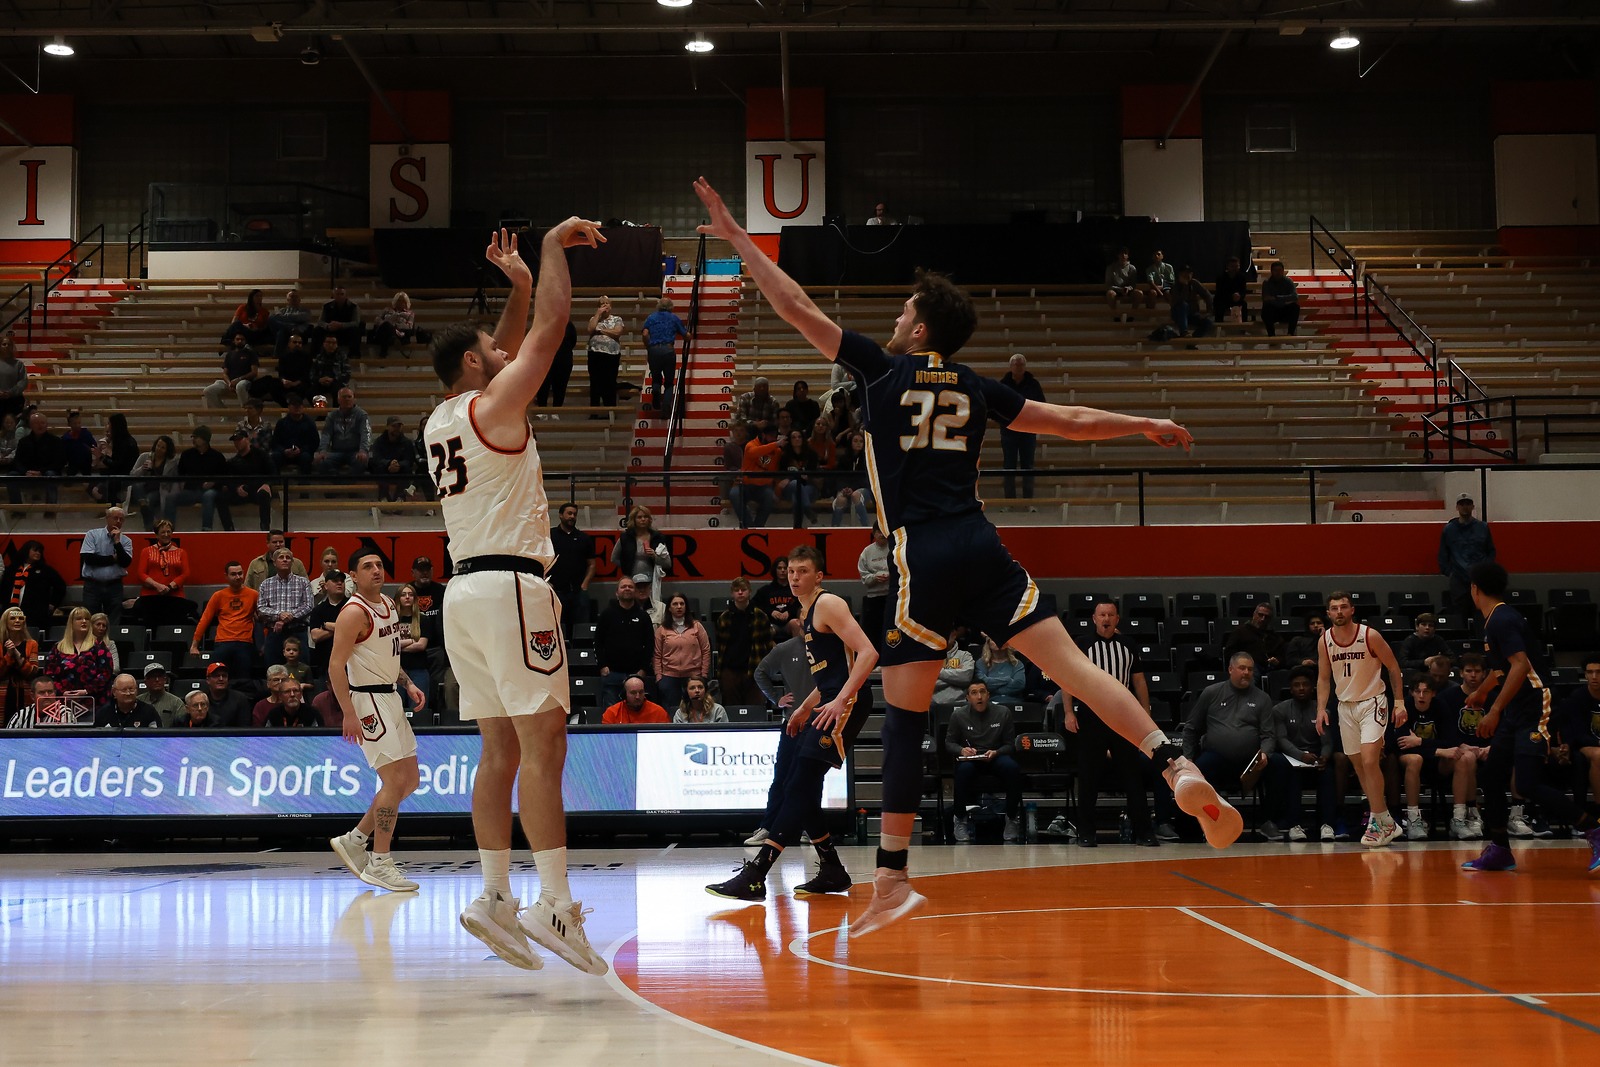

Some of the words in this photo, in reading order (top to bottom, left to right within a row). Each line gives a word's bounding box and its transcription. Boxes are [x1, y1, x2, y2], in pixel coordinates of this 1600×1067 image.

[18, 160, 46, 225] I
[390, 157, 429, 222] S
[755, 154, 816, 219] U
[915, 370, 959, 385] HUGHES
[899, 389, 971, 452] 32
[429, 436, 468, 498] 25
[769, 596, 795, 605] GIANT
[1343, 662, 1351, 677] 11
[1347, 651, 1365, 660] STATE
[3, 757, 164, 799] Leaders
[177, 757, 213, 797] in
[226, 756, 360, 807] Sports
[684, 769, 738, 777] MEDICAL
